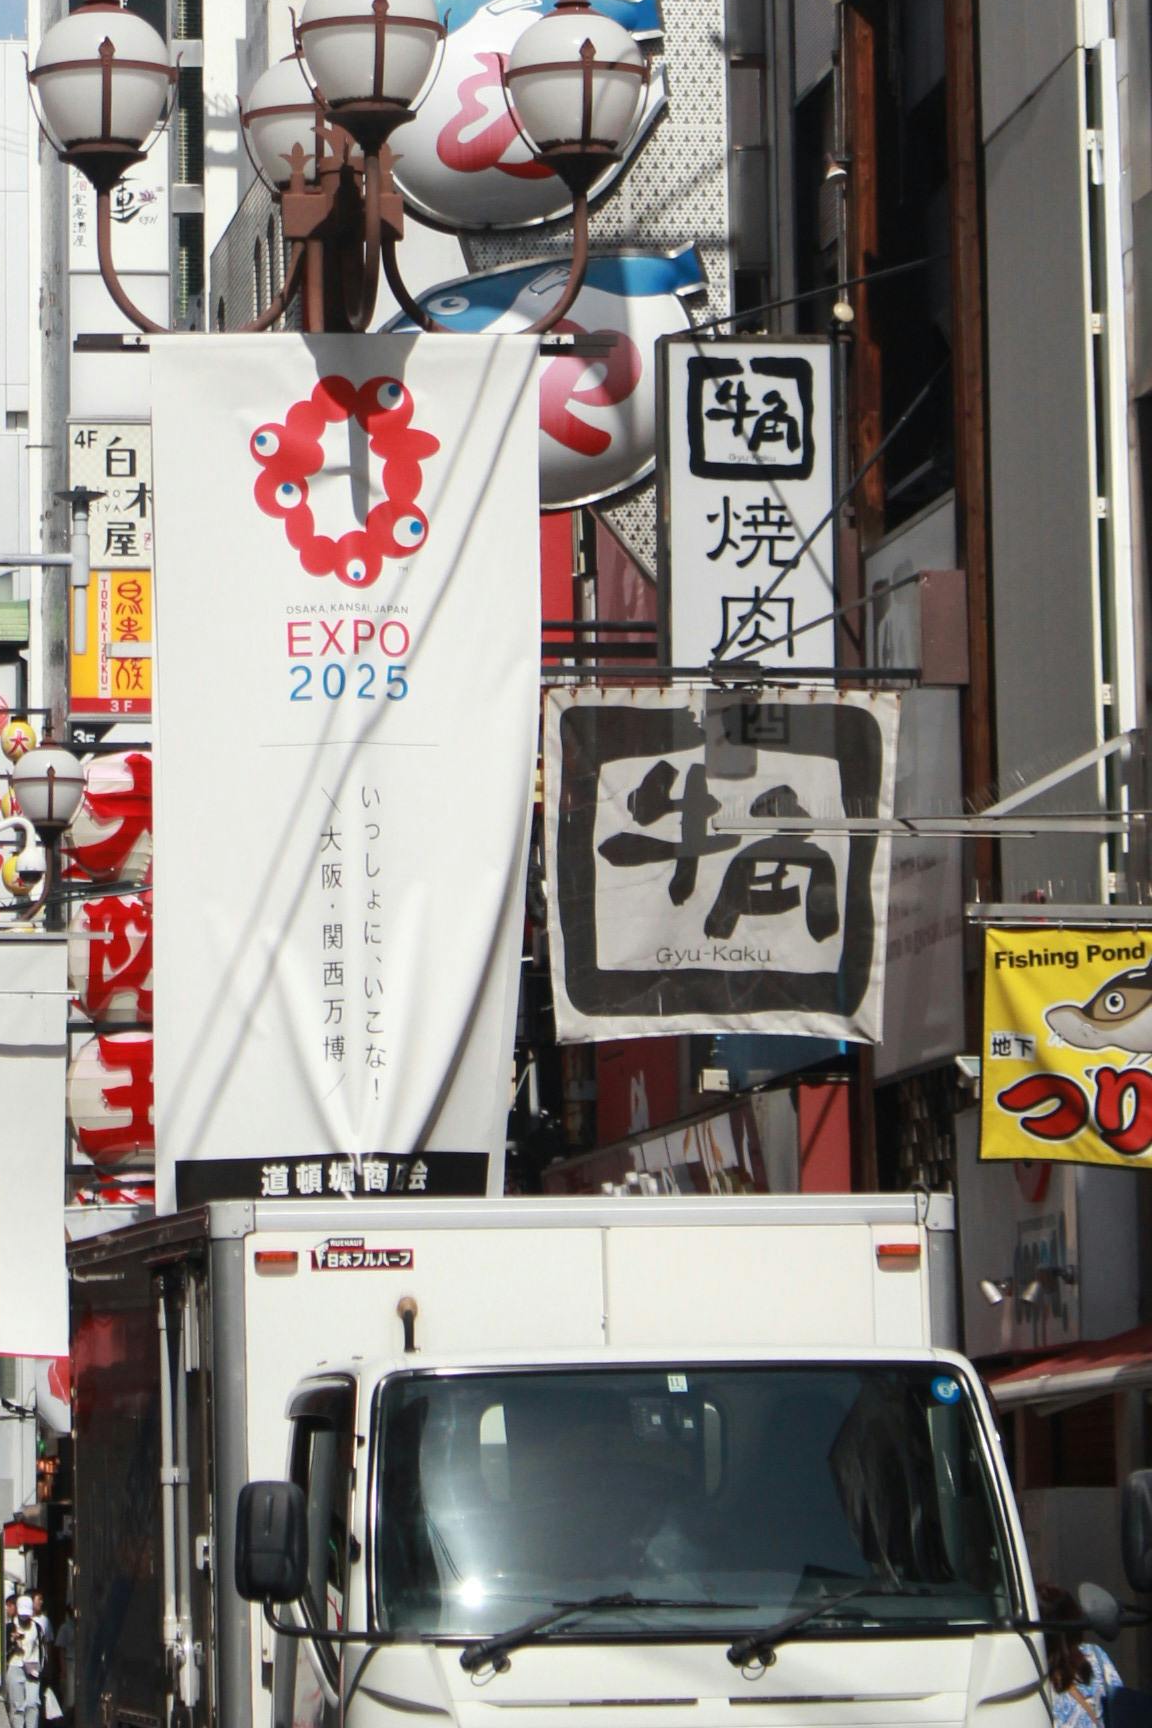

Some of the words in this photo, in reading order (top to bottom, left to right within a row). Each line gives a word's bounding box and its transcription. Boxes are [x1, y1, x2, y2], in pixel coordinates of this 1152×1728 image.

[705, 379, 802, 453] 牛角
[74, 430, 97, 449] 4F
[104, 435, 152, 558] 白木屋
[705, 495, 800, 658] 焼肉
[374, 605, 409, 615] JAPAN
[287, 619, 410, 658] EXPO
[289, 663, 409, 702] 2025
[110, 699, 133, 712] 3F
[598, 760, 840, 943] 牛角
[656, 945, 772, 965] Gyu-Kaku
[994, 949, 1079, 970] Fishing
[1086, 942, 1146, 963] Pond
[991, 1035, 1034, 1058] 地下
[261, 1159, 429, 1197] 道頓堀商会
[327, 1253, 411, 1268] 日本フルハーフ
